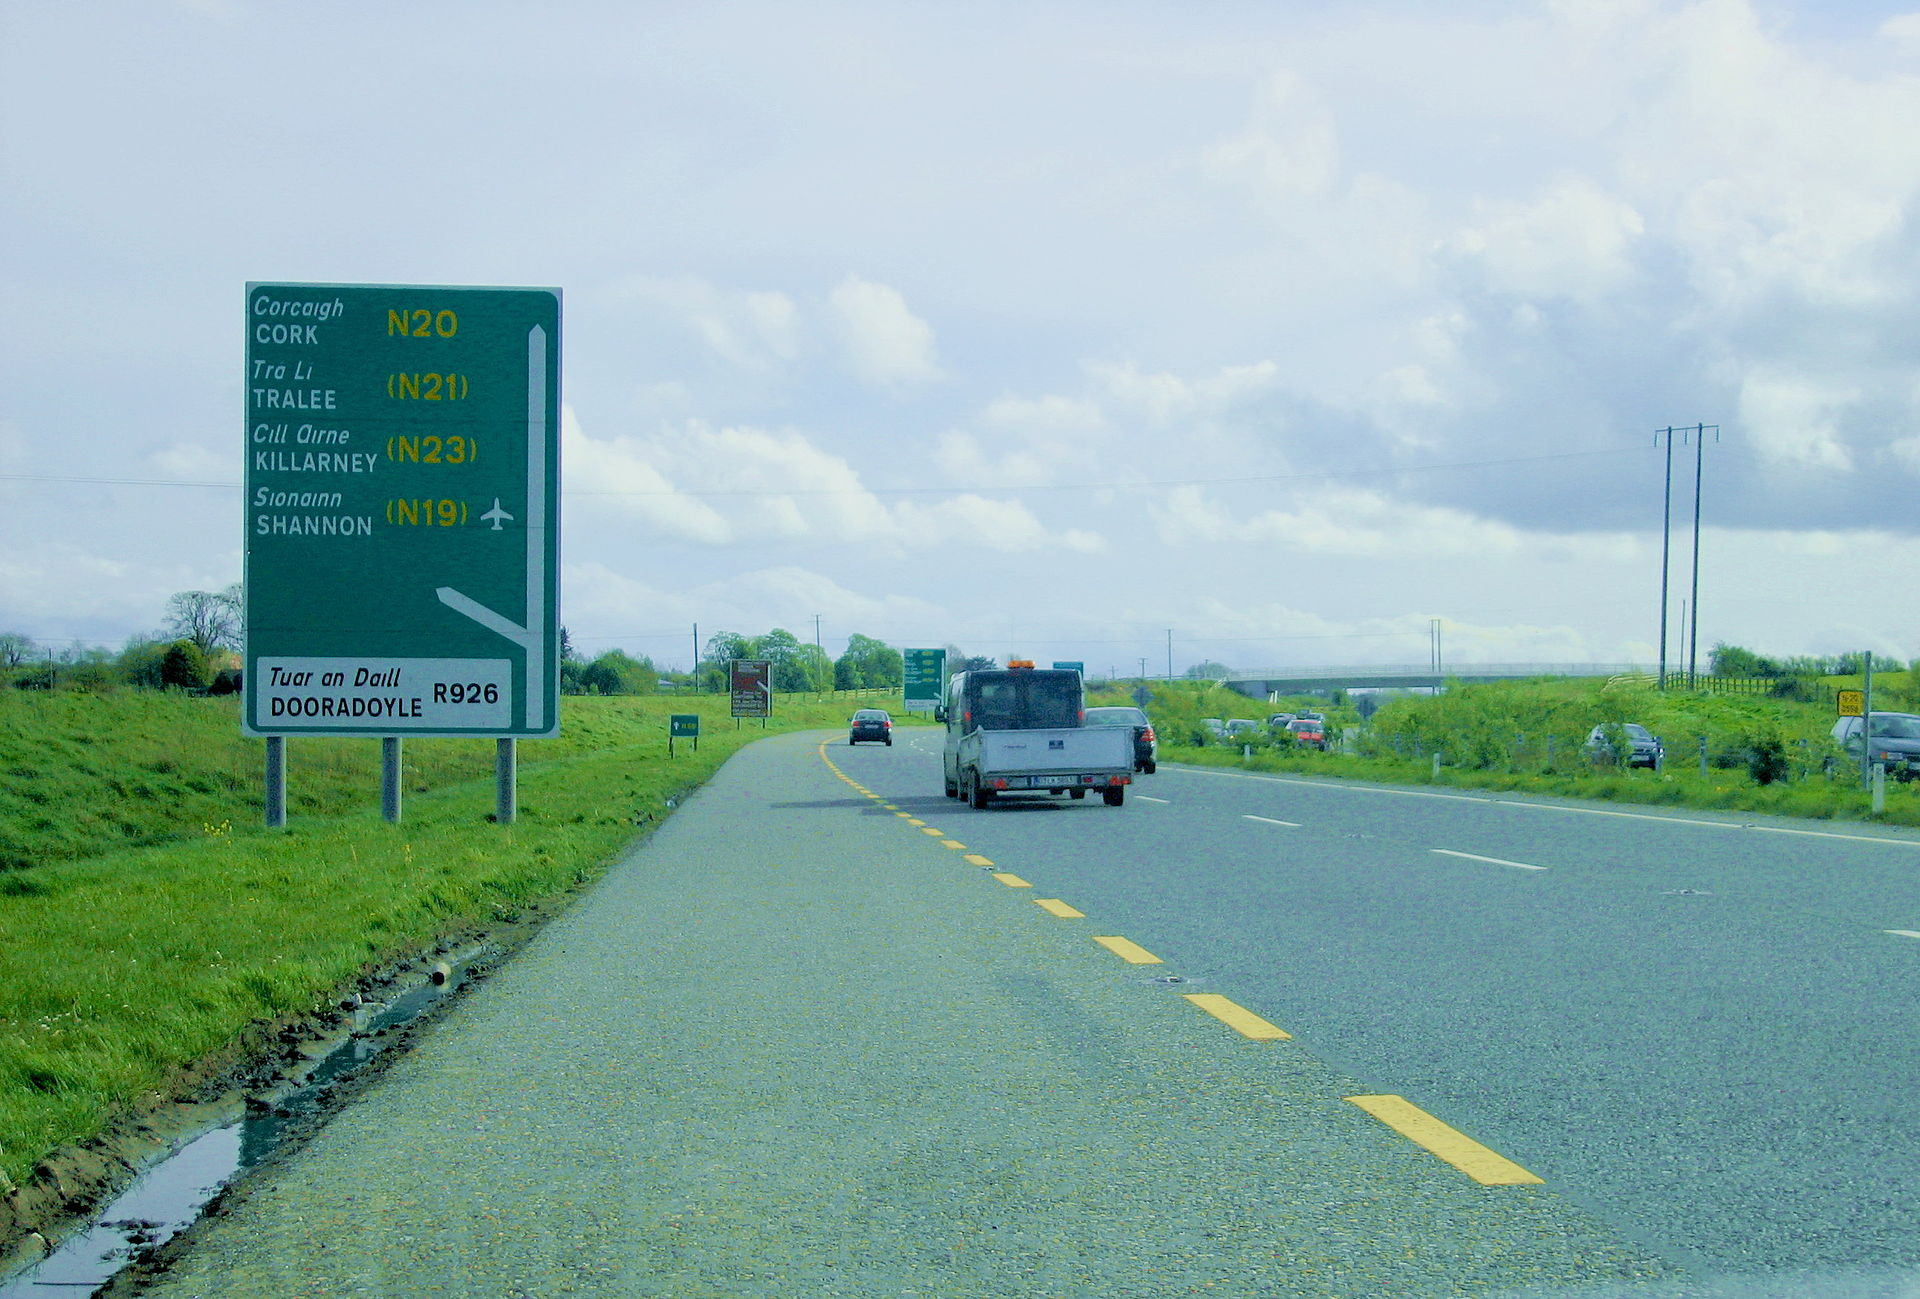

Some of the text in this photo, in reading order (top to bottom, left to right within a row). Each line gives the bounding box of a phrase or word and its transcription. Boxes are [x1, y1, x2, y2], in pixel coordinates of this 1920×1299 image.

[255, 296, 343, 320] Corcaigh
[389, 310, 457, 337] N20
[257, 324, 317, 344] CORK
[388, 373, 467, 400] (N21)
[254, 389, 336, 409] TRALEE
[254, 424, 287, 443] Cill
[387, 436, 476, 463] (N23)
[257, 452, 377, 472] KILLARNEY
[254, 487, 341, 507] Sionainn
[387, 499, 467, 526] (N19)
[257, 515, 371, 535] SHANNON
[271, 667, 402, 687] Tuar an Daill
[433, 683, 499, 704] R926
[271, 697, 422, 718] DOORADOYLE
